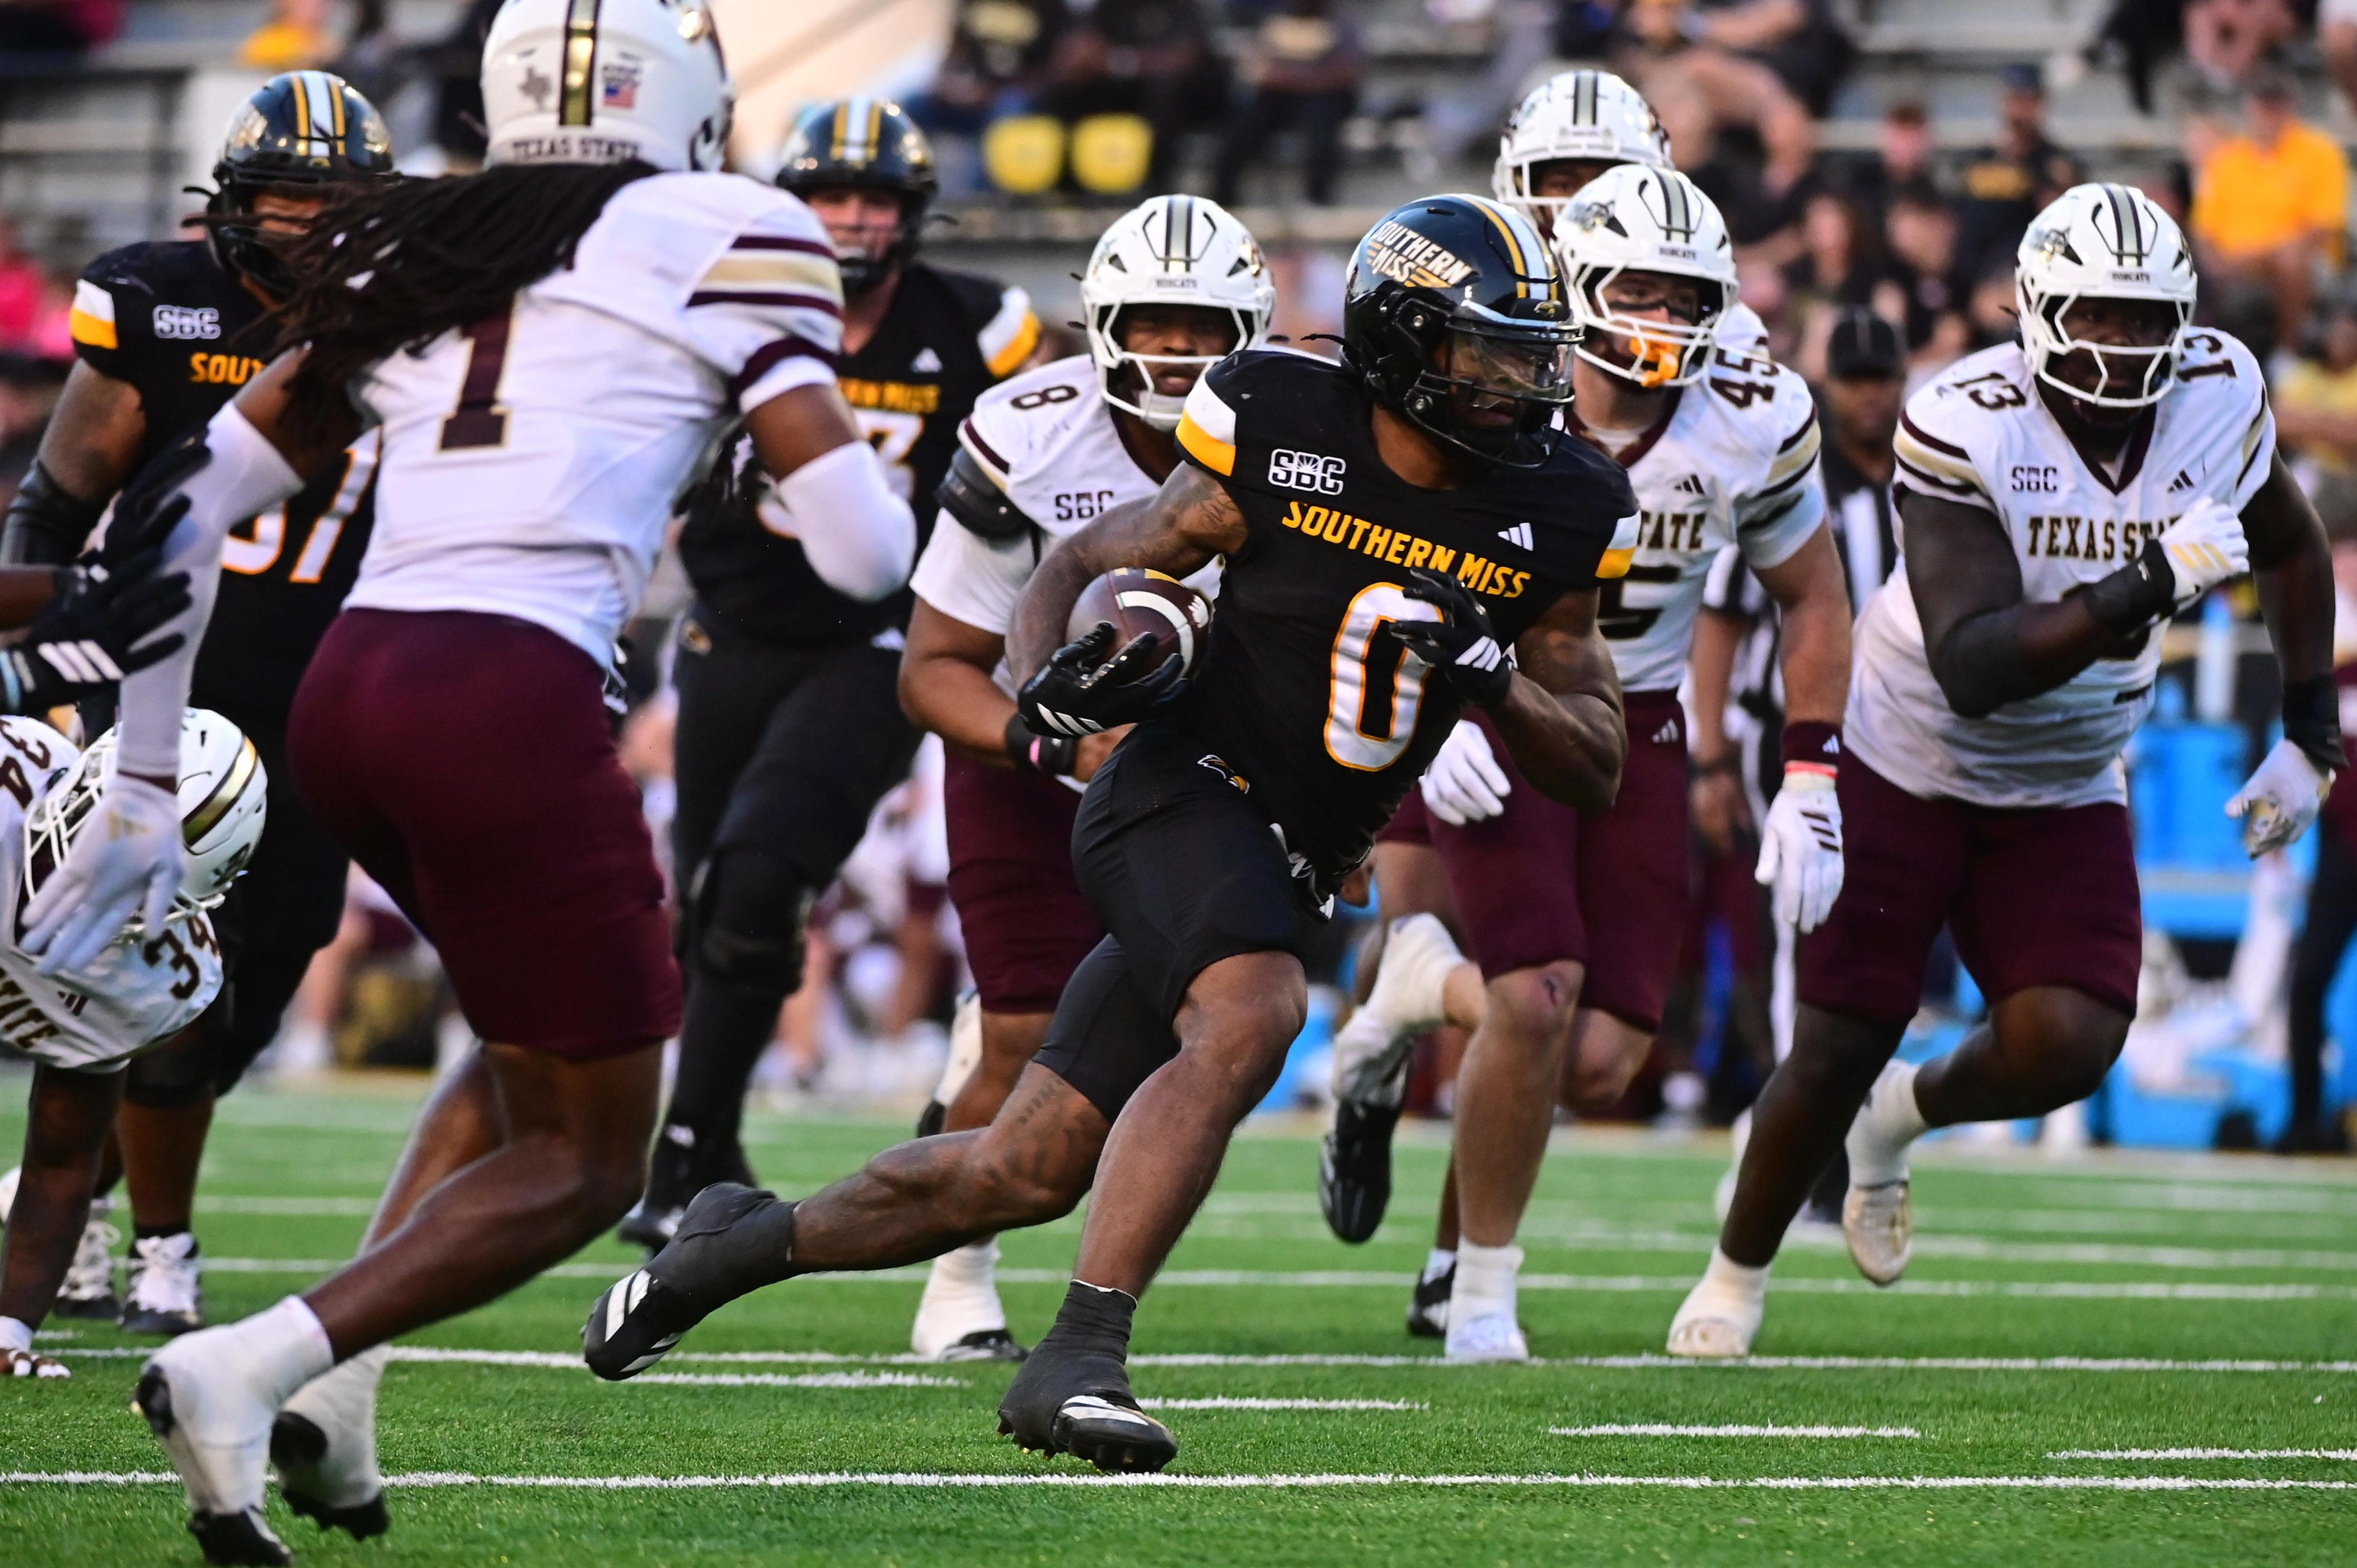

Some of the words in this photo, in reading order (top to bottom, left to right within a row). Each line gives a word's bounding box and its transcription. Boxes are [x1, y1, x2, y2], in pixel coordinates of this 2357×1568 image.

[1370, 220, 1473, 286] SOUTHERN
[1371, 246, 1418, 283] MISS
[1010, 385, 1079, 410] 8
[1710, 347, 1779, 410] 45
[1953, 372, 2026, 411] 13
[1268, 448, 1346, 495] SBC
[2011, 466, 2058, 493] SBC
[1281, 501, 1456, 574] SOUTHERN
[1457, 552, 1532, 599] MISS
[1637, 510, 1706, 550] TATE
[2027, 515, 2115, 561] TEXAS
[1596, 564, 1681, 640] 5
[1324, 581, 1444, 772] 0
